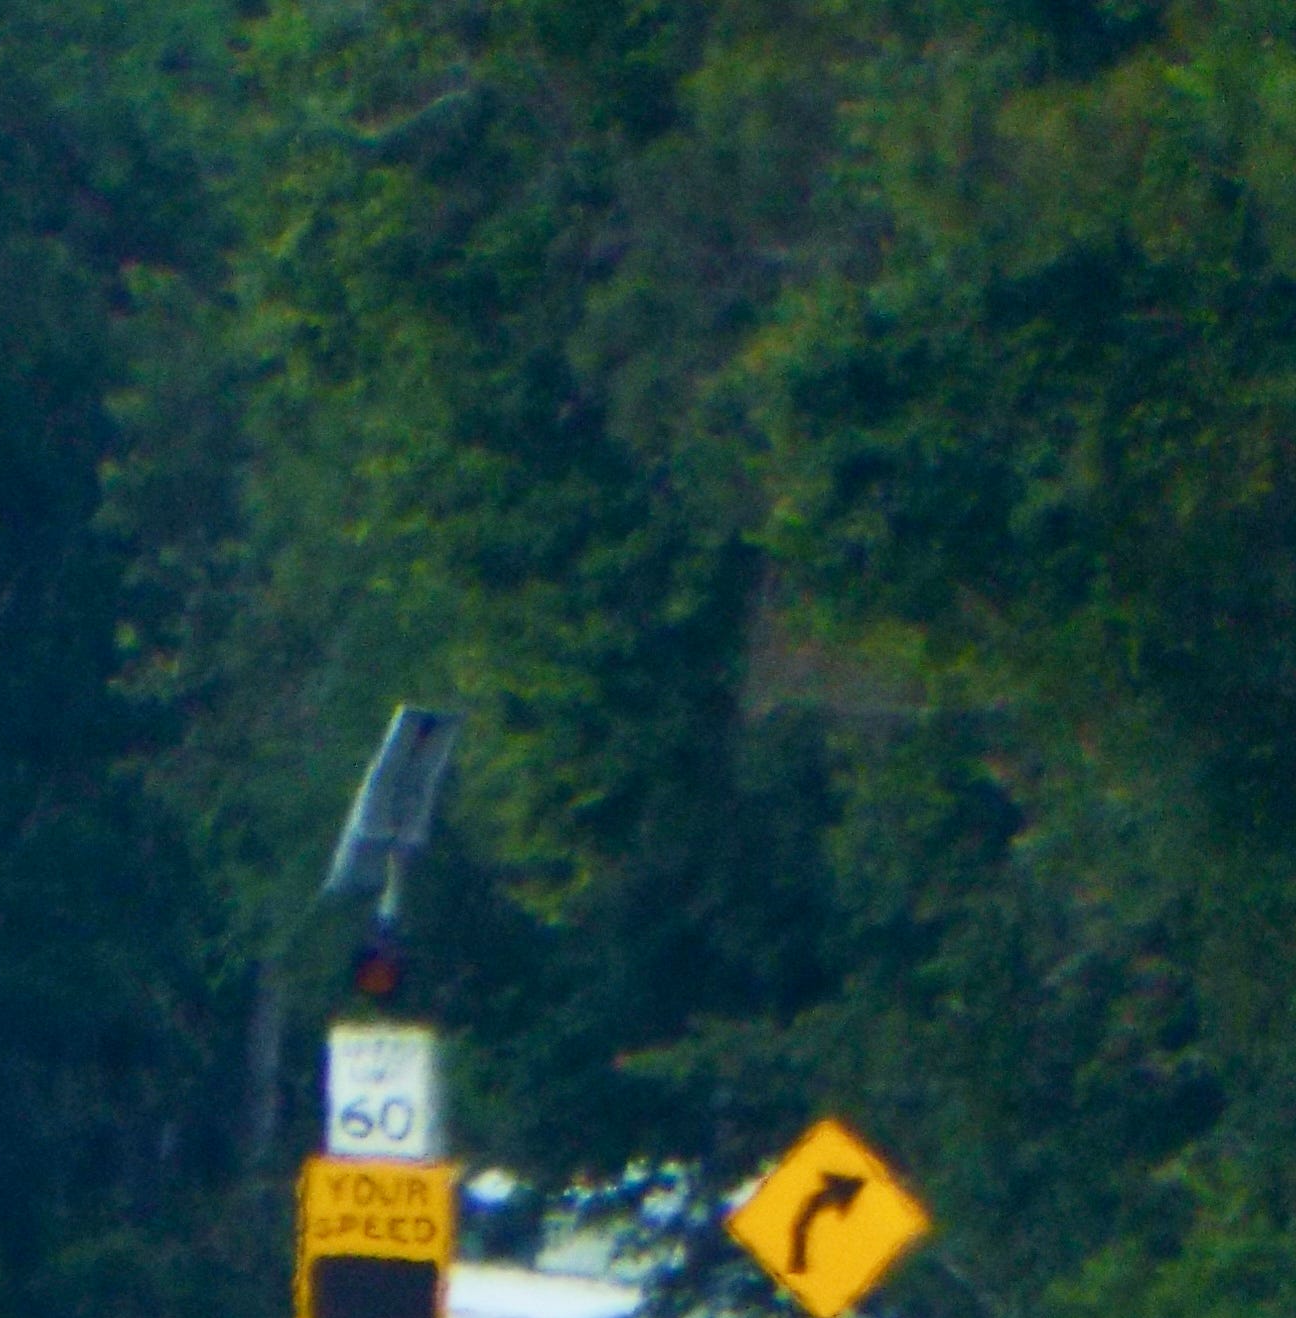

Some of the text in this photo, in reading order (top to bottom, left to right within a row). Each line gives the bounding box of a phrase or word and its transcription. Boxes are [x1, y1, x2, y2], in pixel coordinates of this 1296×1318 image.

[340, 1095, 414, 1142] 60
[328, 1173, 430, 1207] YOUR
[313, 1212, 438, 1244] SPEED
